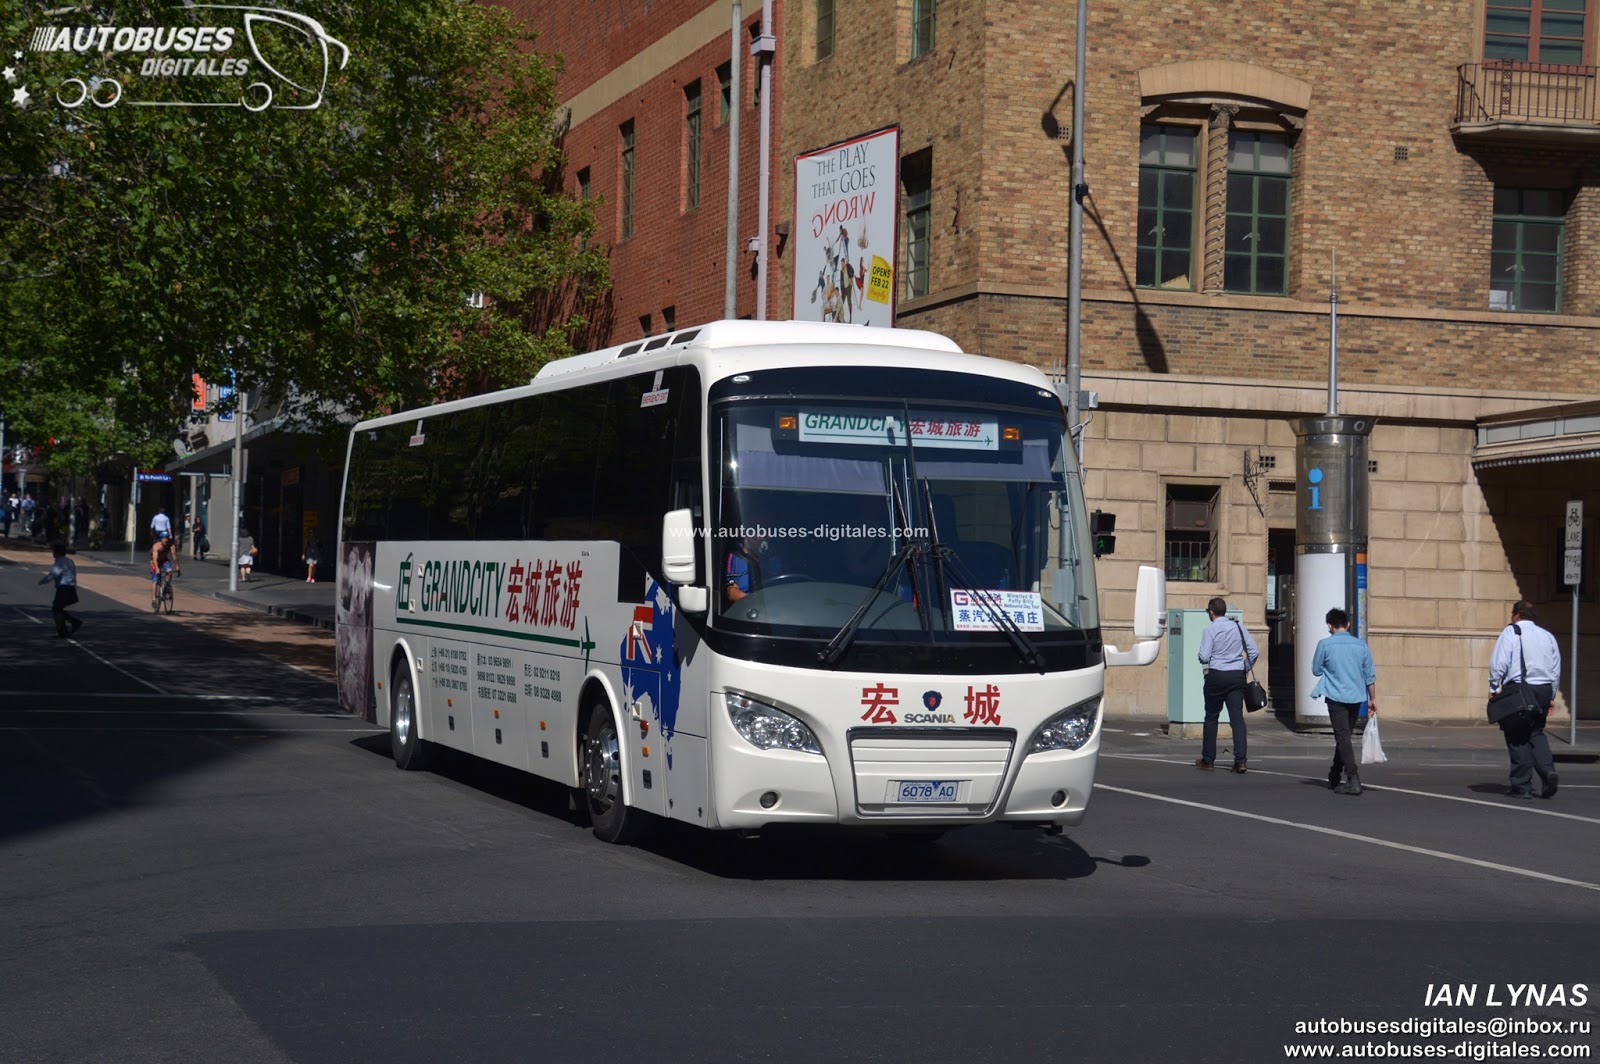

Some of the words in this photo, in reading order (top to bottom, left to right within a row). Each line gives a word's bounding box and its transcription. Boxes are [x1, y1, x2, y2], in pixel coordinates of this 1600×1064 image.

[817, 157, 836, 177] THE
[839, 142, 870, 171] PLAY
[812, 178, 838, 199] THAT
[840, 165, 876, 194] GOES
[872, 266, 891, 279] OPENS
[871, 276, 881, 287] FEB
[881, 279, 889, 290] 22
[804, 412, 907, 433] GRANDCIY
[909, 418, 982, 438] 宏城旅游
[1566, 531, 1580, 542] LANE
[421, 560, 506, 619] GRANDCITY
[505, 558, 583, 631] 宏城旅游
[860, 682, 900, 725] 宏
[963, 683, 1002, 726] 城
[904, 713, 956, 724] SCANIA
[902, 786, 932, 797] 6078
